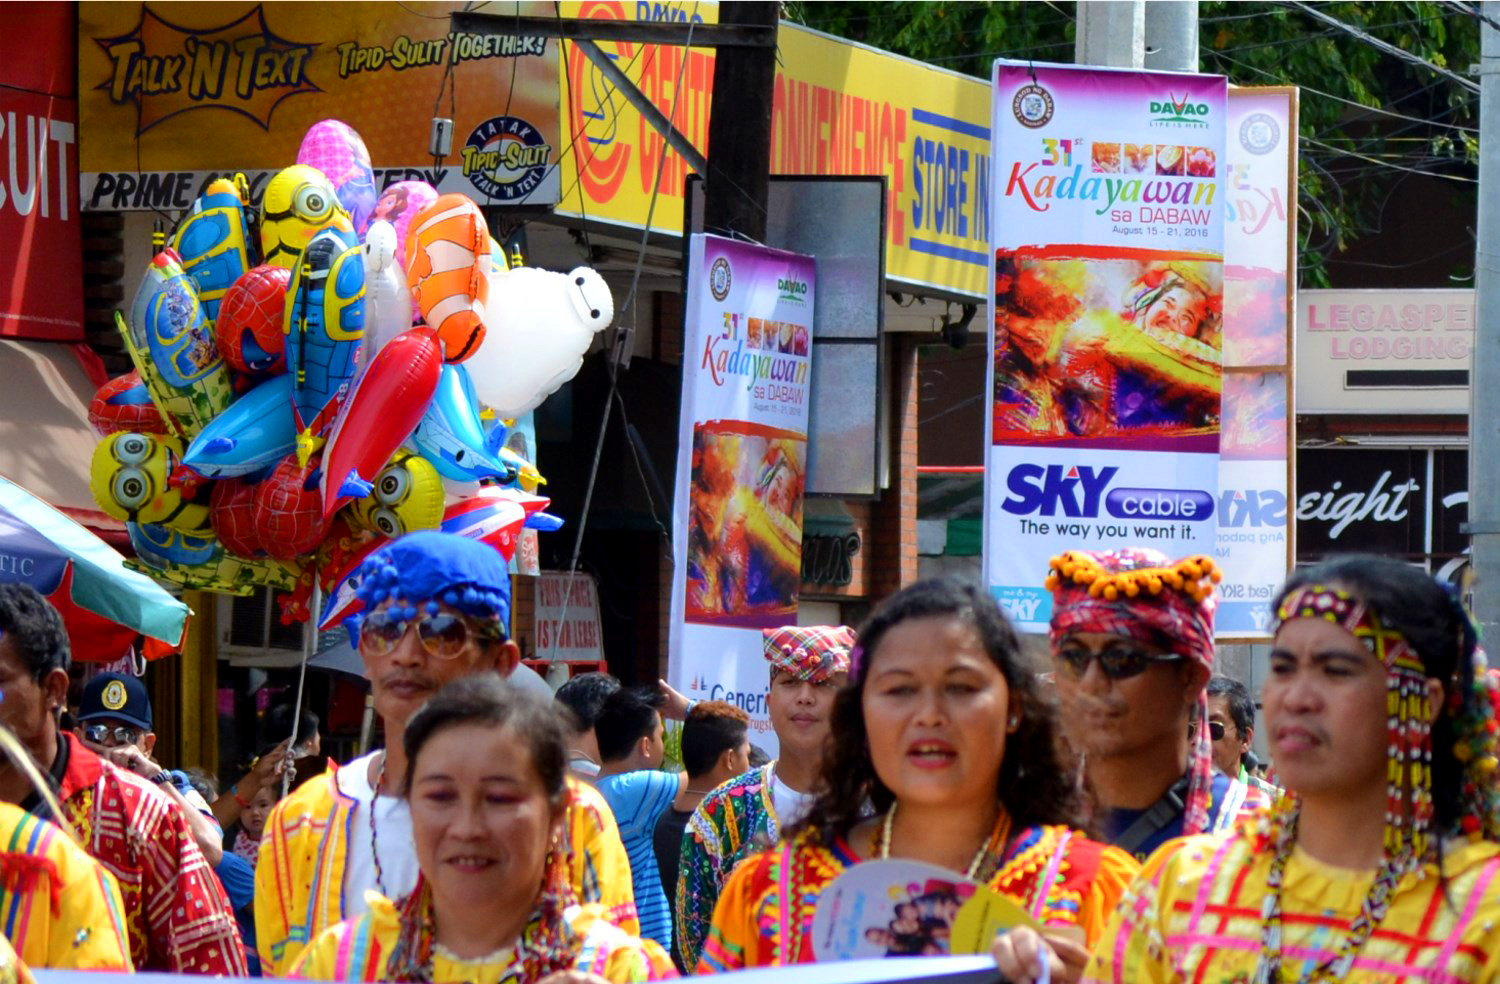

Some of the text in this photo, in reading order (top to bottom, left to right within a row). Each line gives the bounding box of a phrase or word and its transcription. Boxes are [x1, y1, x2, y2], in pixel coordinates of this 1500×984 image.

[108, 38, 185, 104] TALK
[234, 33, 312, 99] TEXT
[337, 35, 448, 79] TIPID-SULIT
[1150, 96, 1210, 116] DAVAO
[476, 120, 531, 141] TATAK
[0, 111, 75, 221] UIT
[768, 72, 907, 246] ONVENIENCE
[90, 172, 194, 208] PRIME
[474, 173, 499, 196] TALK
[519, 170, 542, 194] TEXT
[912, 135, 969, 238] STORE
[1005, 162, 1217, 216] Kadayawan
[1111, 207, 1212, 226] sa DABAW
[1112, 225, 1143, 236] August
[1147, 226, 1158, 235] 15
[1184, 229, 1209, 238] 2016
[778, 275, 807, 294] DAVAO
[1330, 336, 1470, 360] LODGING
[701, 335, 808, 391] Kadayawan
[753, 384, 804, 405] sa DABAW
[1001, 463, 1120, 518] SKY
[1122, 493, 1197, 517] cable
[1020, 519, 1196, 541] The way you want it.
[711, 684, 769, 714] Generi
